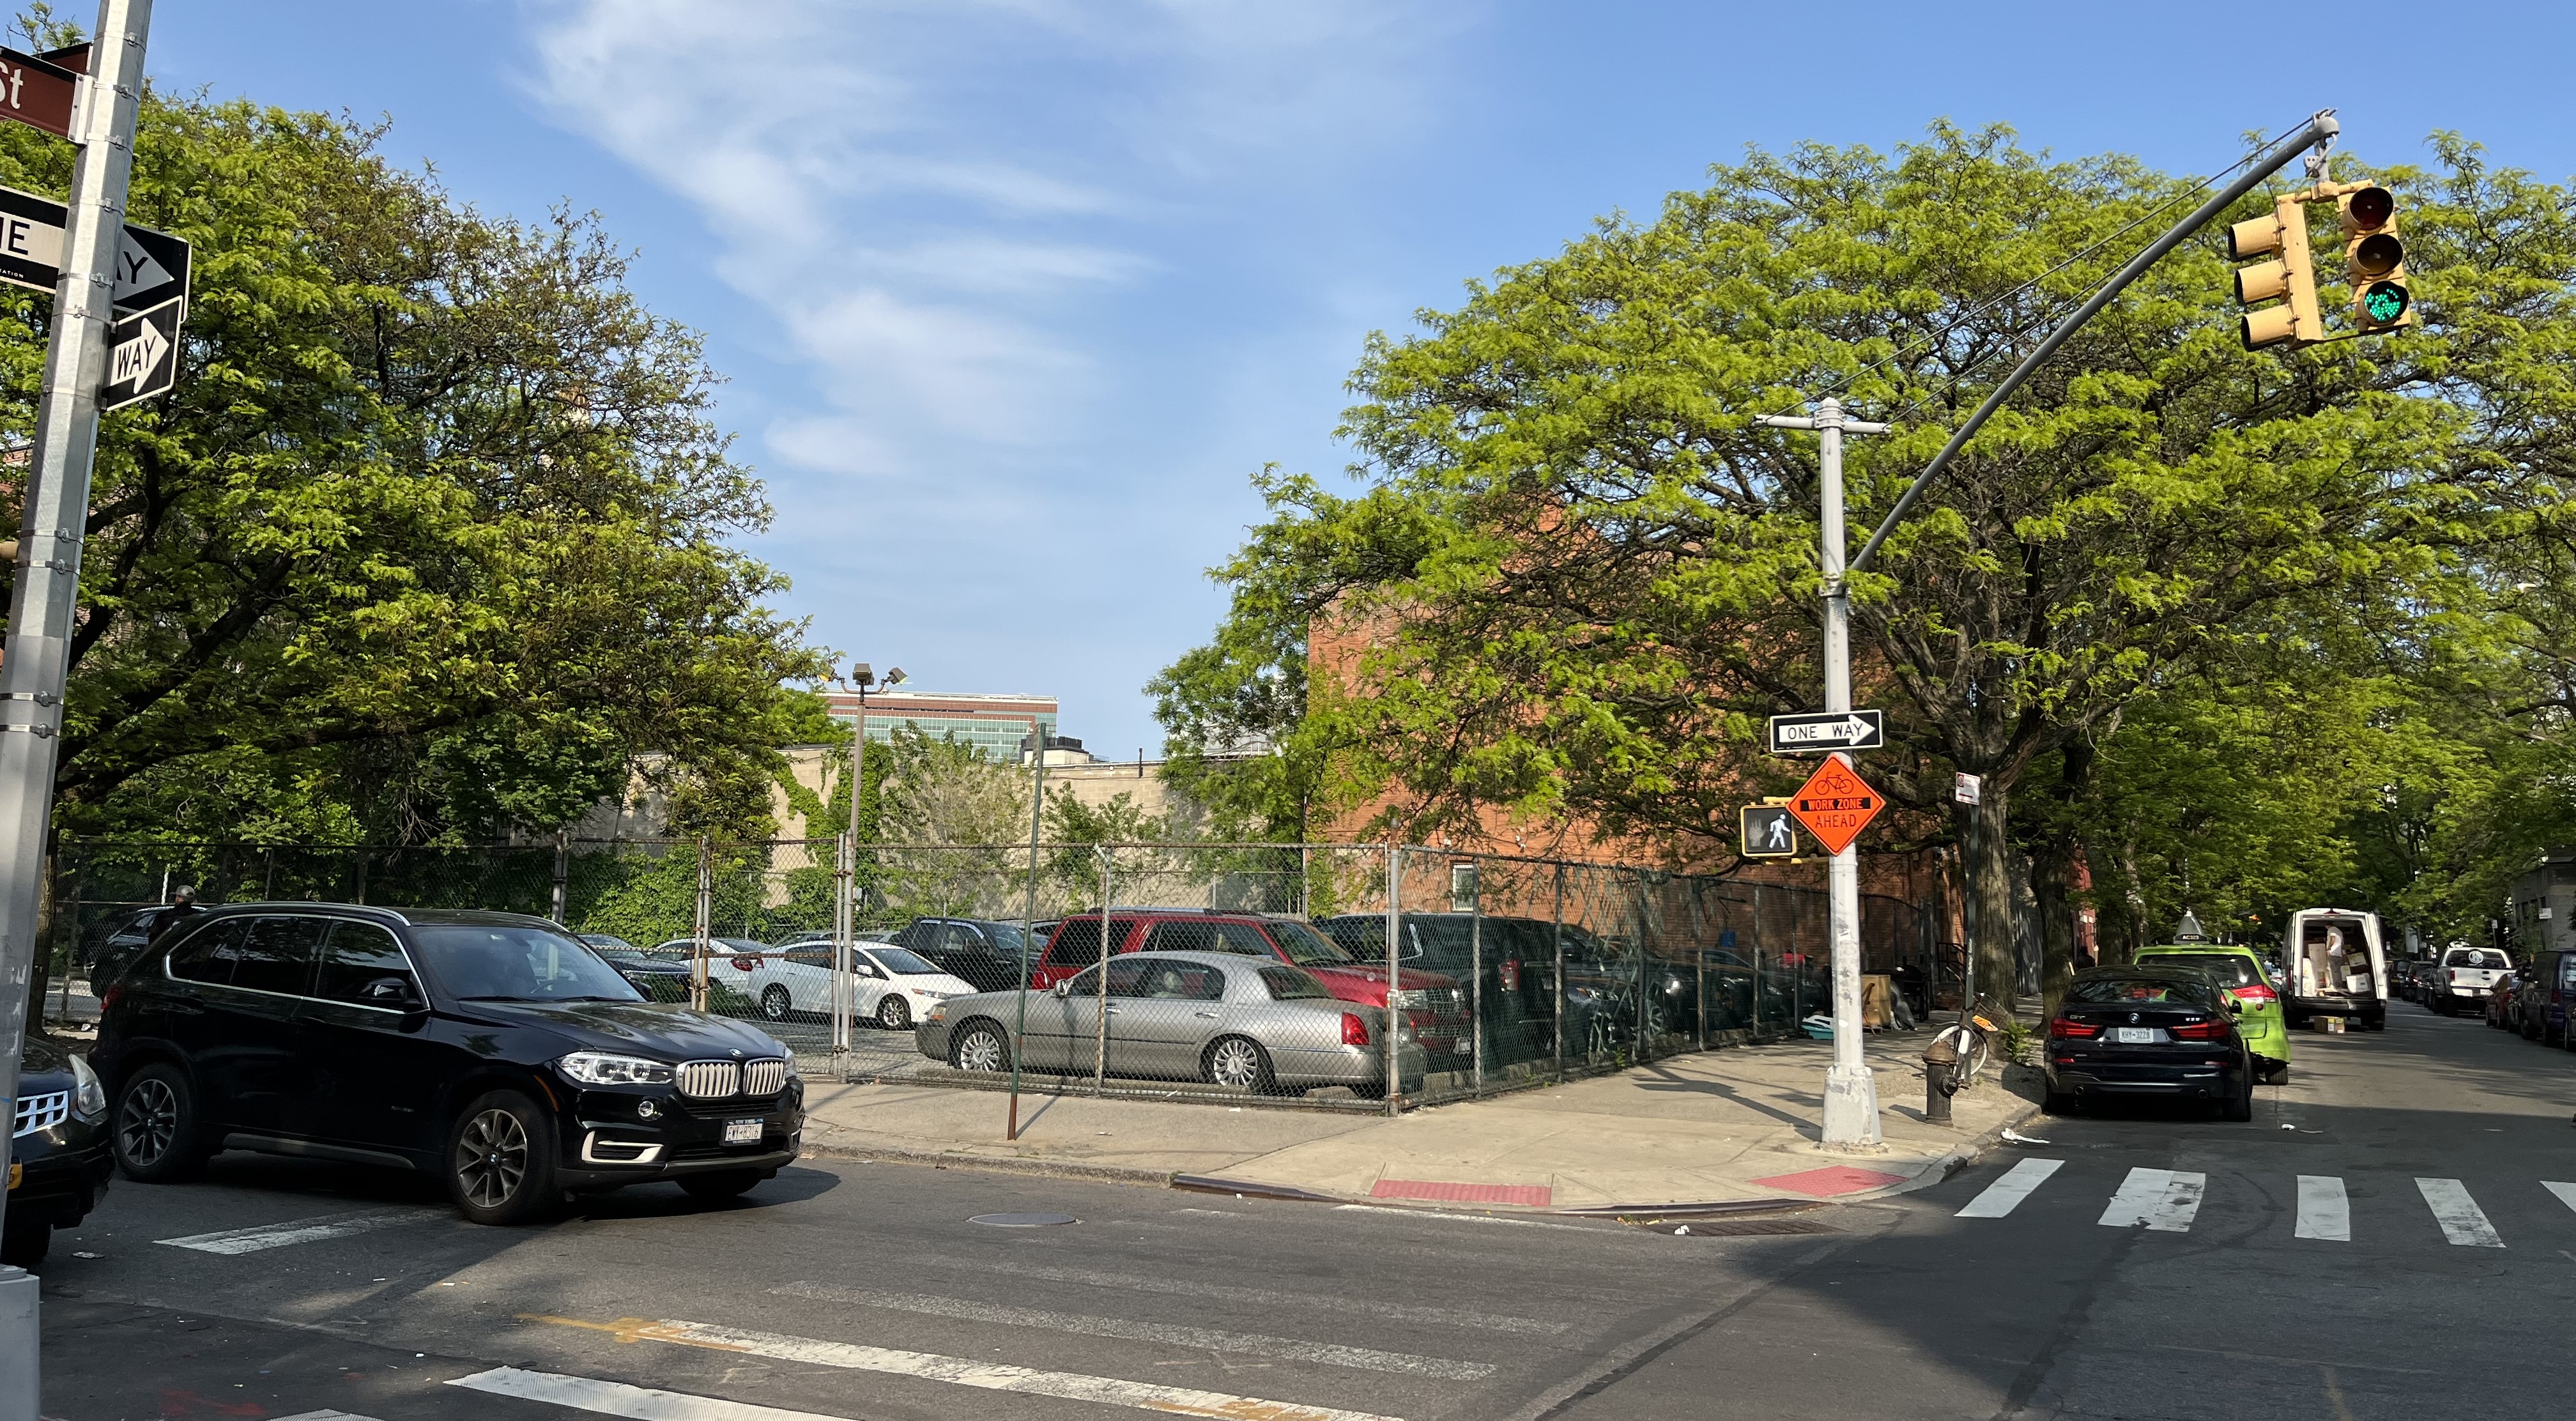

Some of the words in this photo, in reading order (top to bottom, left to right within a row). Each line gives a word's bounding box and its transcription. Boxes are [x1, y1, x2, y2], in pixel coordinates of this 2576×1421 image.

[0, 216, 30, 256] E
[117, 335, 157, 380] WAY
[1788, 725, 1818, 740] ONE
[1832, 723, 1864, 737] WAY
[1807, 799, 1835, 811] WORK
[1837, 798, 1864, 810] ZONE
[1815, 814, 1857, 829] AHEAD
